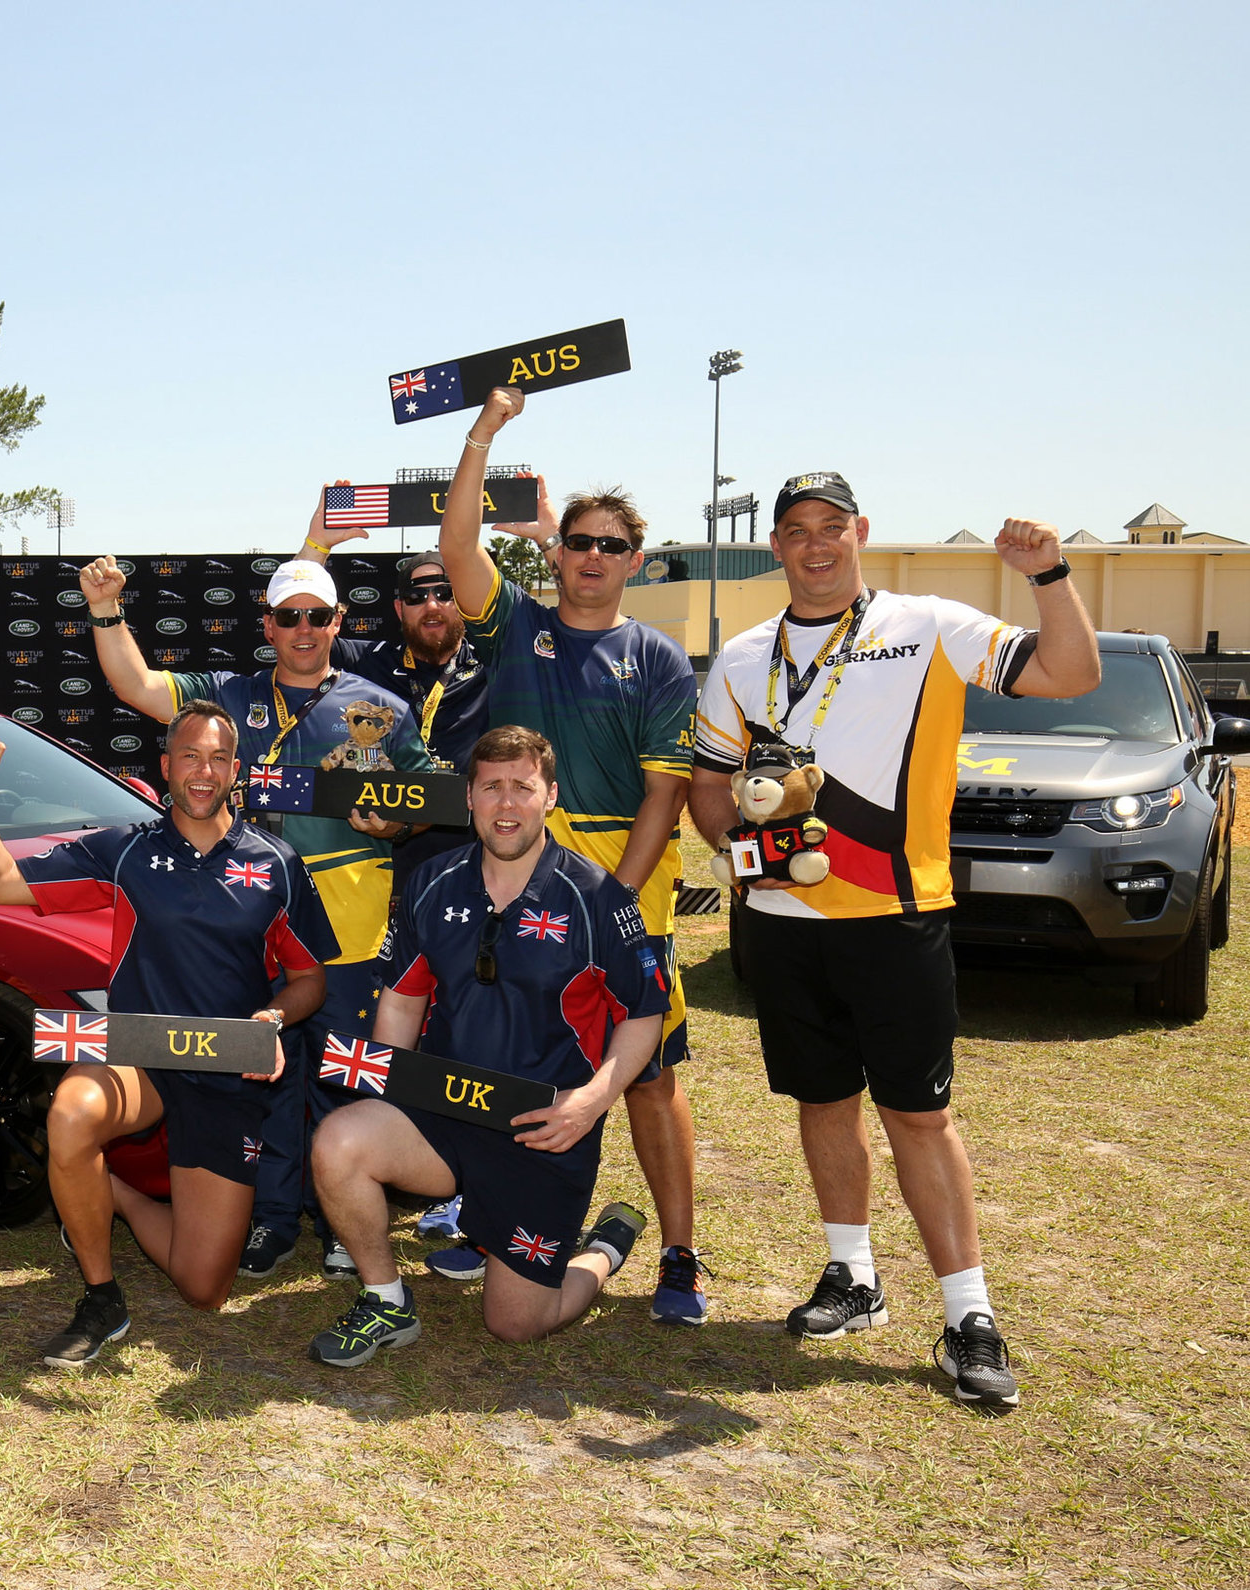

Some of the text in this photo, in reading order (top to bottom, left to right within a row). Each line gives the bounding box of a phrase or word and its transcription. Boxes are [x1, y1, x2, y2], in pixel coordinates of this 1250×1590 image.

[508, 344, 581, 384] AUS
[430, 491, 497, 514] UA
[54, 621, 92, 629] INVICTUS
[816, 616, 852, 662] COMPETITOR
[824, 643, 921, 667] GRMANY
[355, 782, 425, 810] AUS
[167, 1030, 218, 1057] UK
[444, 1074, 495, 1111] UK
